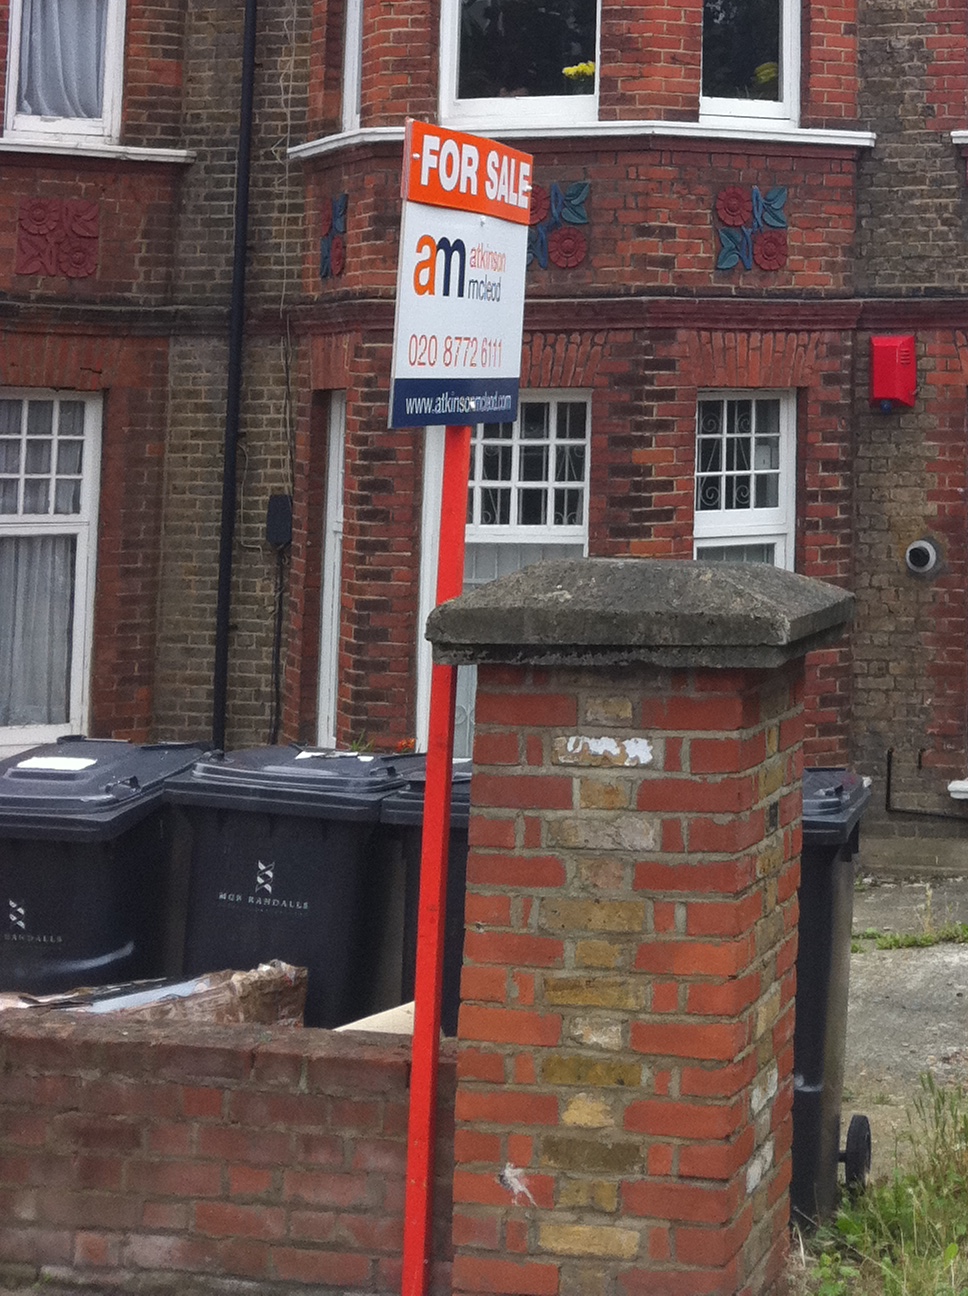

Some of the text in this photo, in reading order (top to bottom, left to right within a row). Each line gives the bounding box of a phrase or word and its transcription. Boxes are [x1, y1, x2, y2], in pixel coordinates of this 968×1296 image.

[421, 134, 531, 209] FOR SALE
[413, 234, 466, 298] am
[469, 243, 506, 272] atkinson
[468, 274, 501, 302] mcleod
[408, 334, 502, 368] 020 8772 6111
[248, 896, 309, 910] RANDALLS
